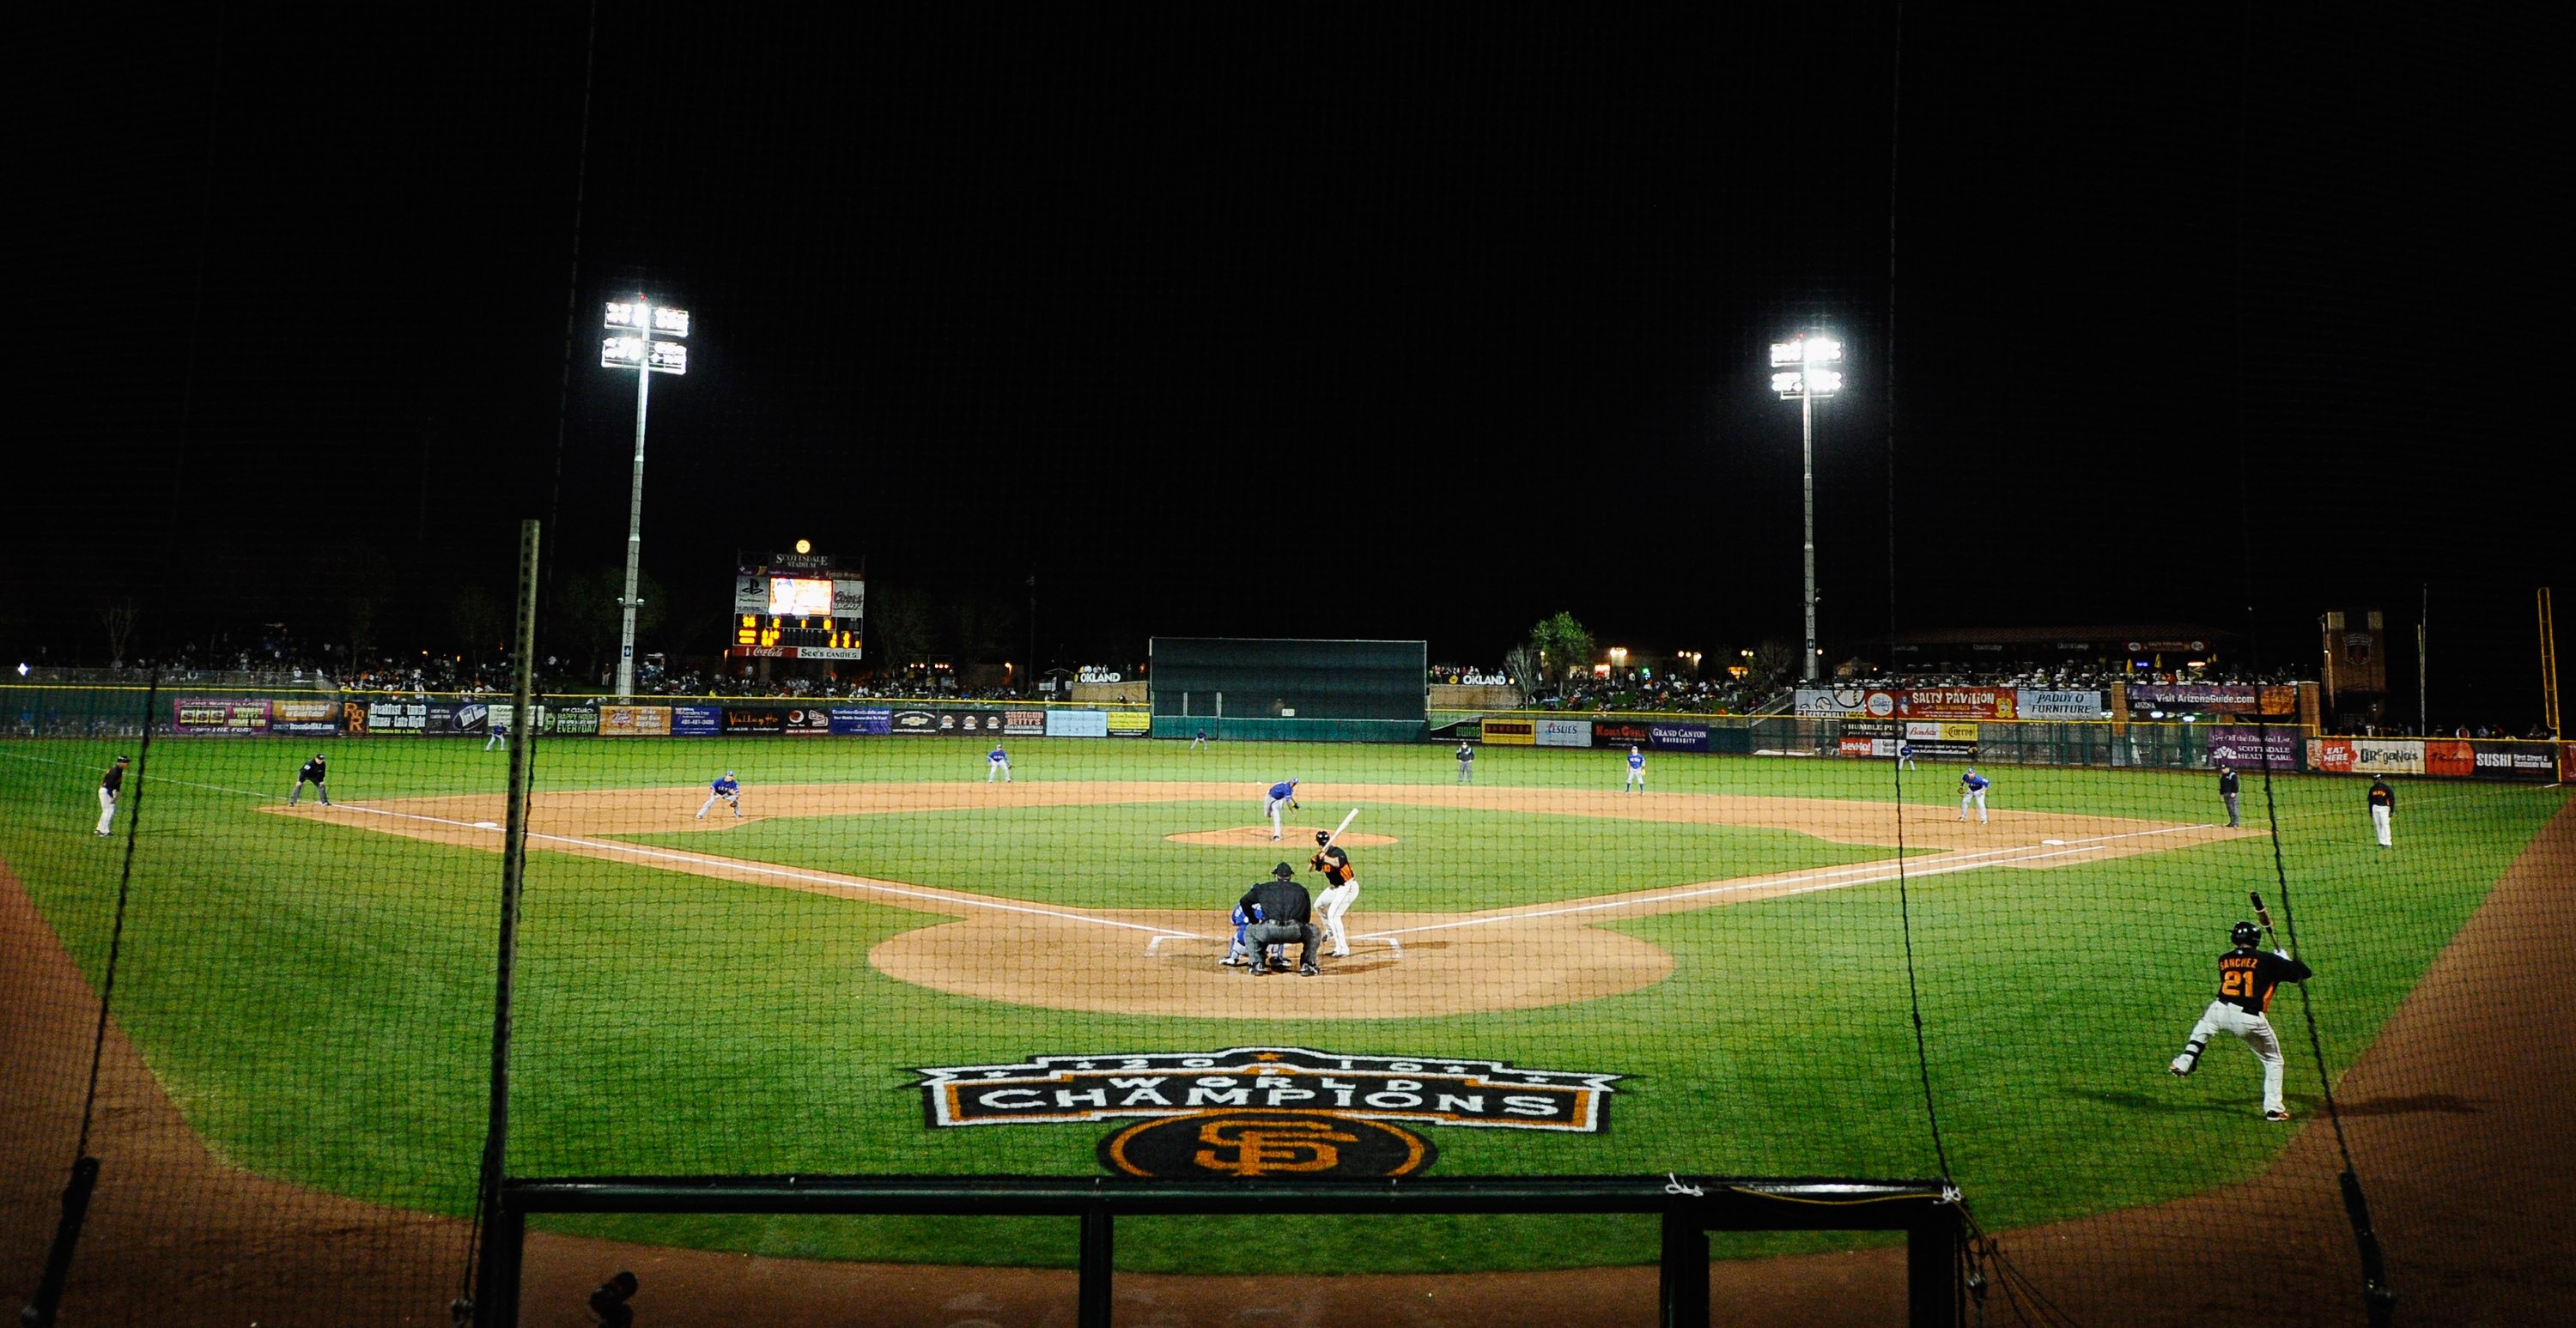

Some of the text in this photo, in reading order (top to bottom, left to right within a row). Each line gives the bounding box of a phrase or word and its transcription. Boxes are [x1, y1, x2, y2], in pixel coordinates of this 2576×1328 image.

[776, 554, 828, 566] SCOTTSDALE
[753, 646, 783, 657] Coca-Cola
[801, 648, 824, 657] See's
[1080, 672, 1121, 683] OKLAND
[1462, 675, 1506, 685] OKLAND
[1912, 692, 1943, 704] SALTY
[2037, 694, 2074, 703] PADDY
[2156, 694, 2255, 704] Visit ArizonaGuide.com
[370, 702, 402, 715] Breakfast
[407, 704, 426, 715] Lunch
[2032, 704, 2092, 713] FURNITURE
[369, 715, 426, 728] Dinner Late Night
[728, 710, 763, 726] Valley
[556, 725, 597, 733] EVERYDAY
[1456, 726, 1481, 737] EWING
[1548, 724, 1577, 734] LESLIE'S
[1653, 728, 1706, 738] GRAND CANYON
[1842, 742, 1871, 751] BevMo!
[2326, 746, 2346, 755] EAT
[2476, 753, 2512, 767] SUSHI
[2220, 957, 2258, 970] SANCHEZ
[2221, 970, 2254, 998] 21
[1109, 1076, 1424, 1092] WORLD
[978, 1087, 1559, 1118] CHAMPIONS
